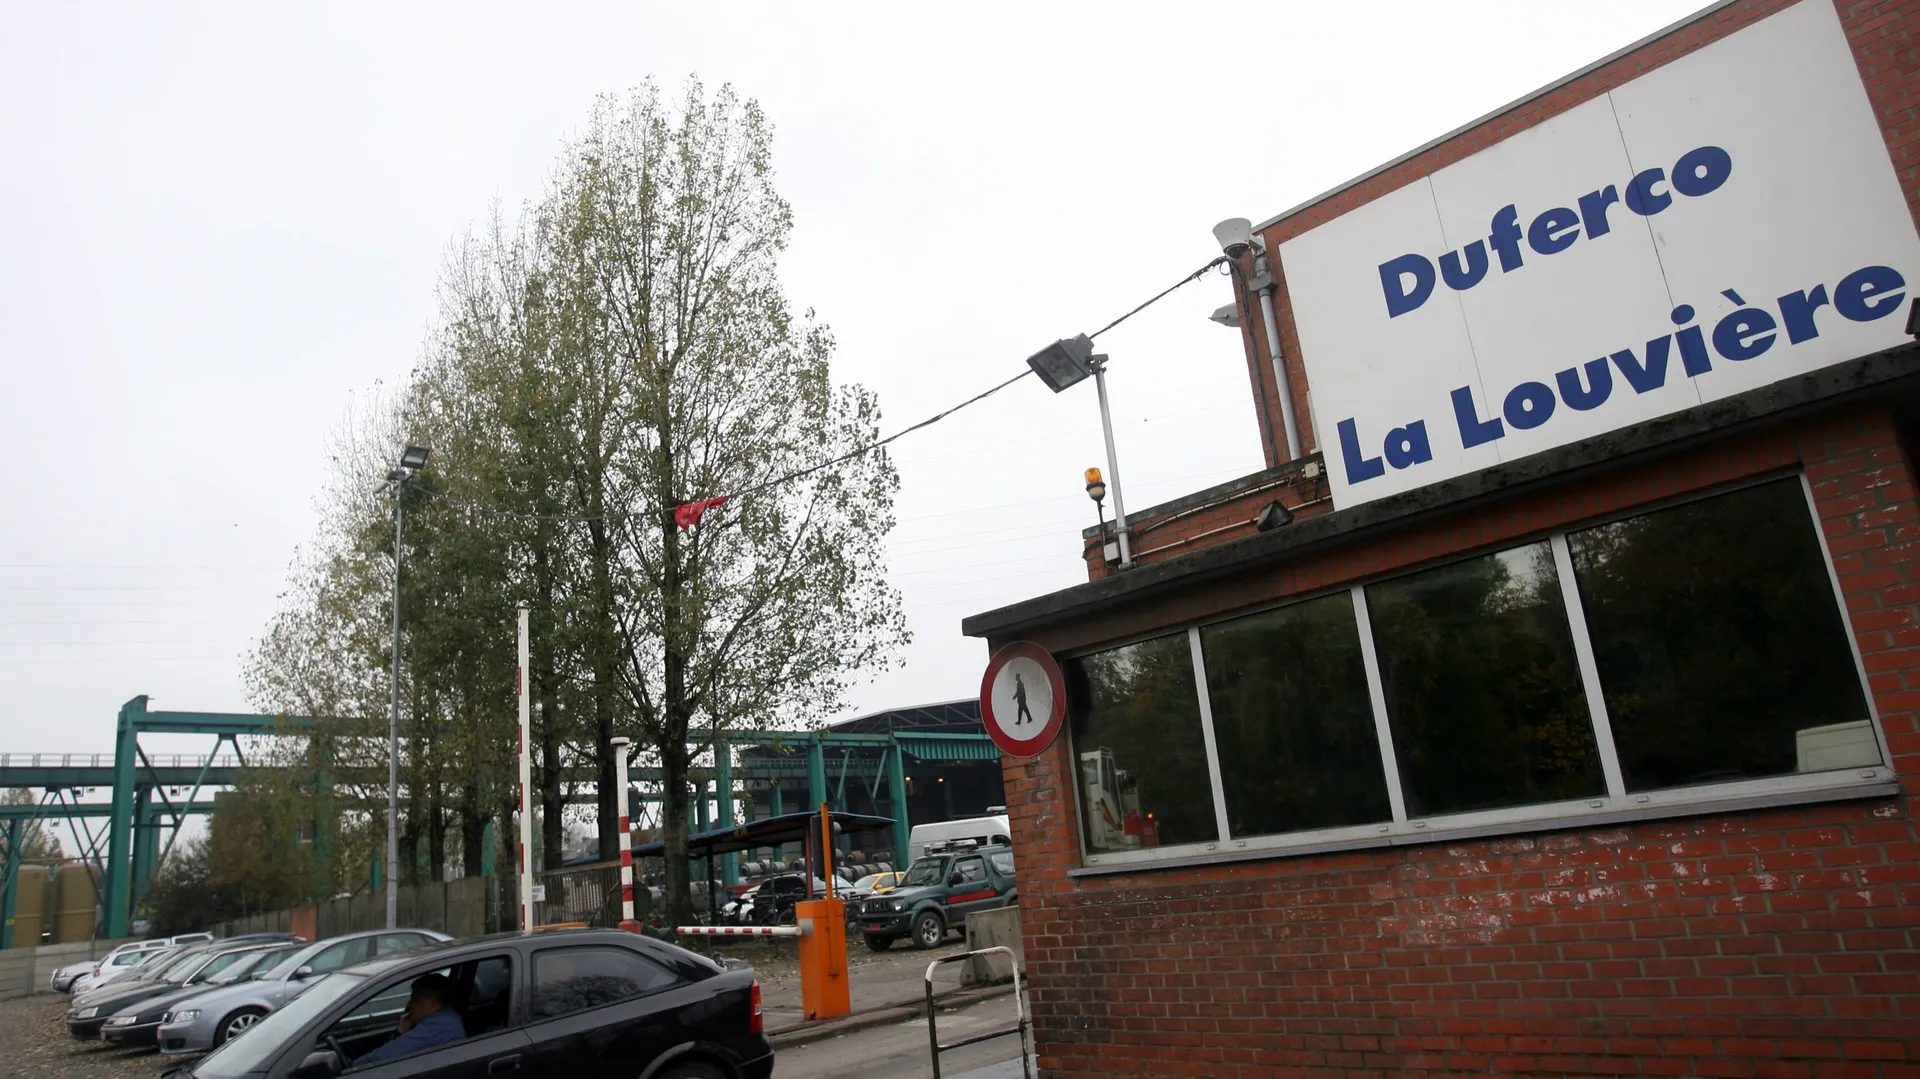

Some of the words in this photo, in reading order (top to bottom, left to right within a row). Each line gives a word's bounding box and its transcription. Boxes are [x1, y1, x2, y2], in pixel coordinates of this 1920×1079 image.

[1378, 146, 1731, 318] Duferco
[1337, 417, 1432, 485] La
[1450, 265, 1906, 449] Louvière
